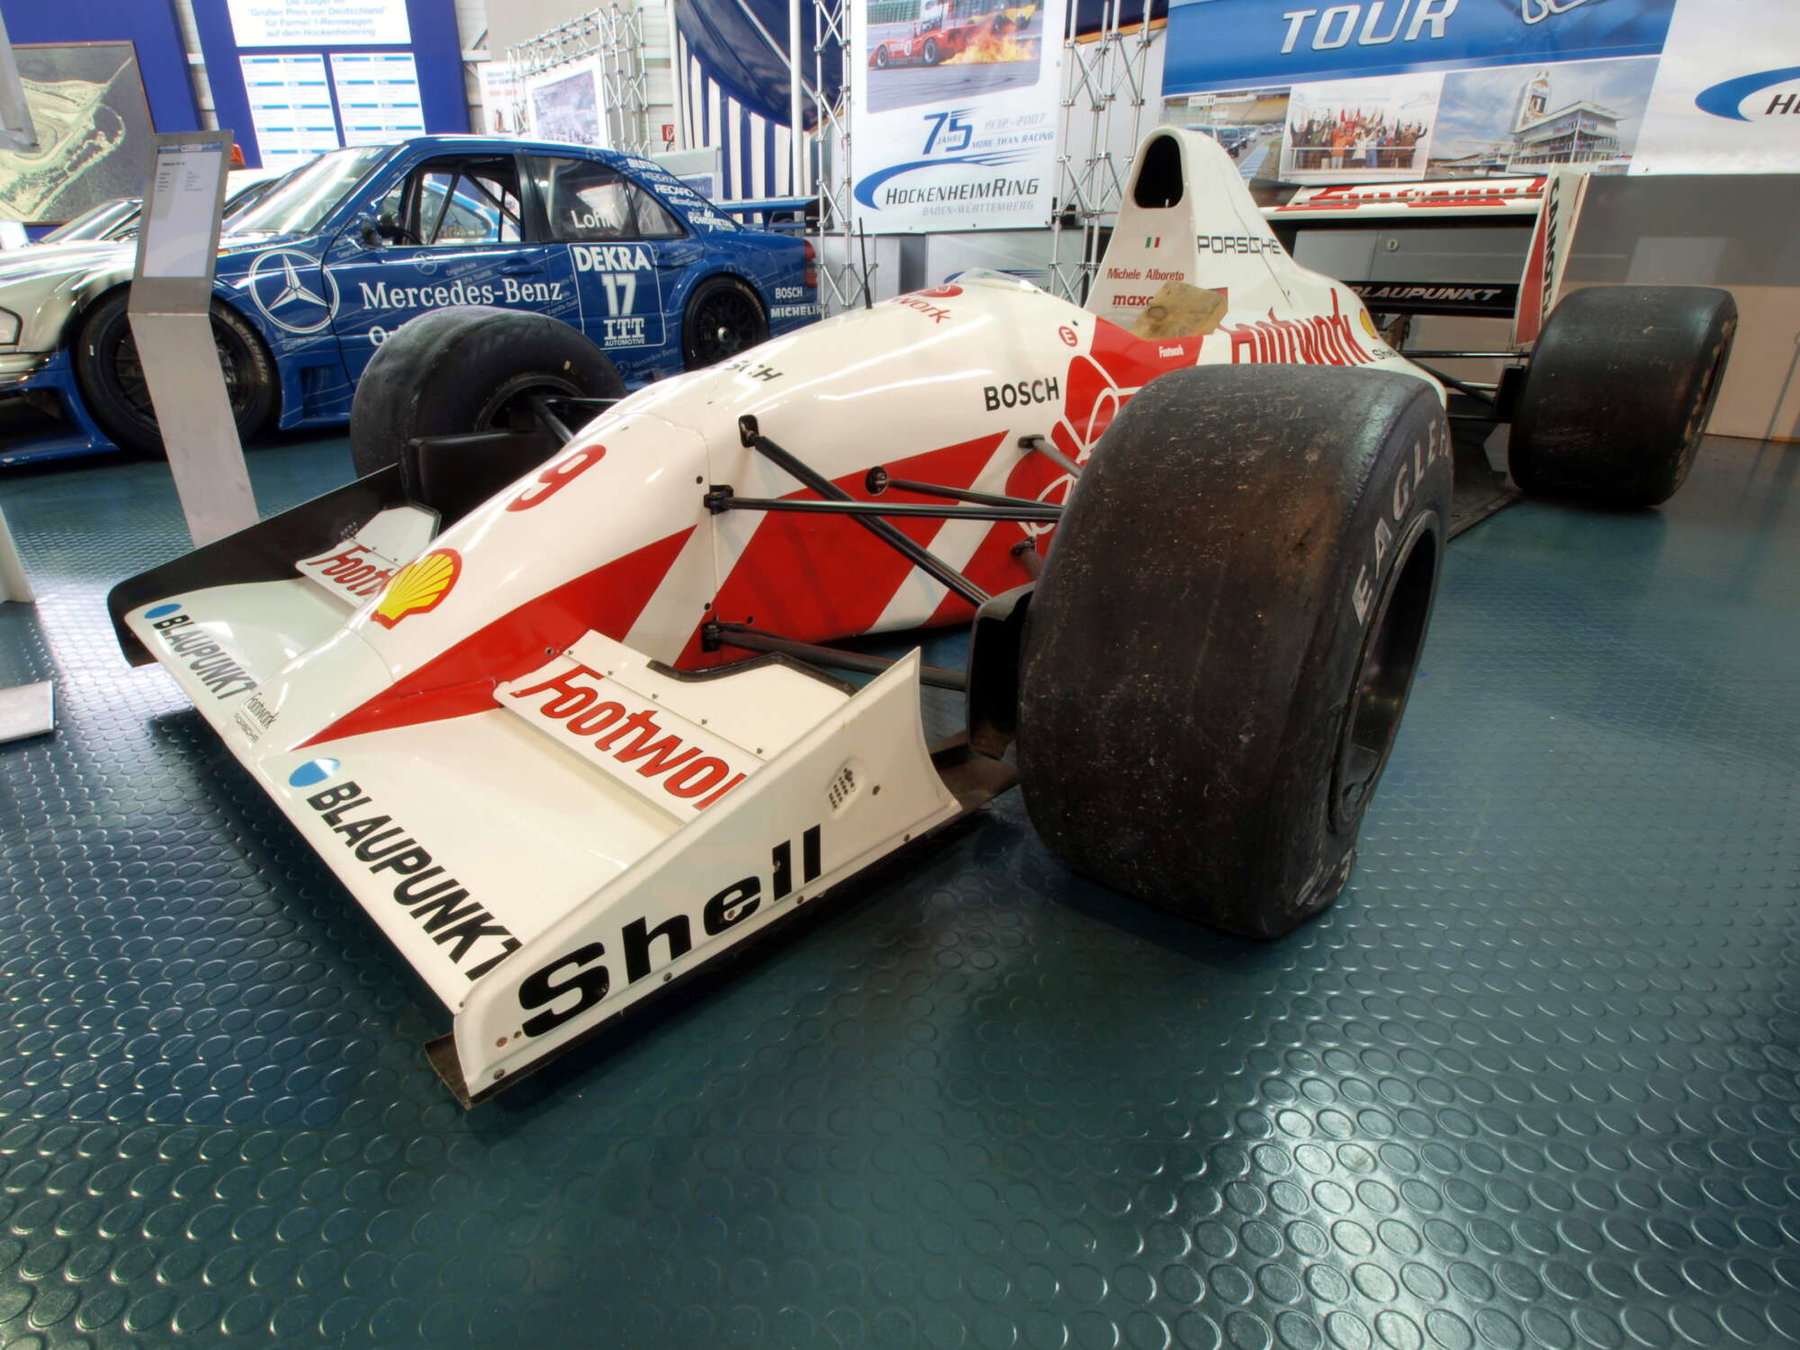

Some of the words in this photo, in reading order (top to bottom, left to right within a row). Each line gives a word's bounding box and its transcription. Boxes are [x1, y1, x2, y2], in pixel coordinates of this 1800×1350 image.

[1280, 0, 1460, 54] TOUR
[922, 111, 973, 155] 75
[573, 245, 653, 272] DEKRA
[1196, 235, 1281, 254] PORSCHE
[1107, 267, 1142, 280] Michele
[1146, 268, 1185, 281] Alboreto
[358, 278, 563, 310] Mercedes-Benz
[601, 272, 637, 317] 17
[775, 286, 803, 300] BOSCH
[603, 317, 645, 341] ITT
[604, 337, 645, 347] AUTOMOTIVE
[983, 377, 1060, 412] BOSCH
[505, 444, 607, 512] 9
[306, 780, 524, 983] BLAUPUNKT
[518, 823, 822, 1038] Shell
